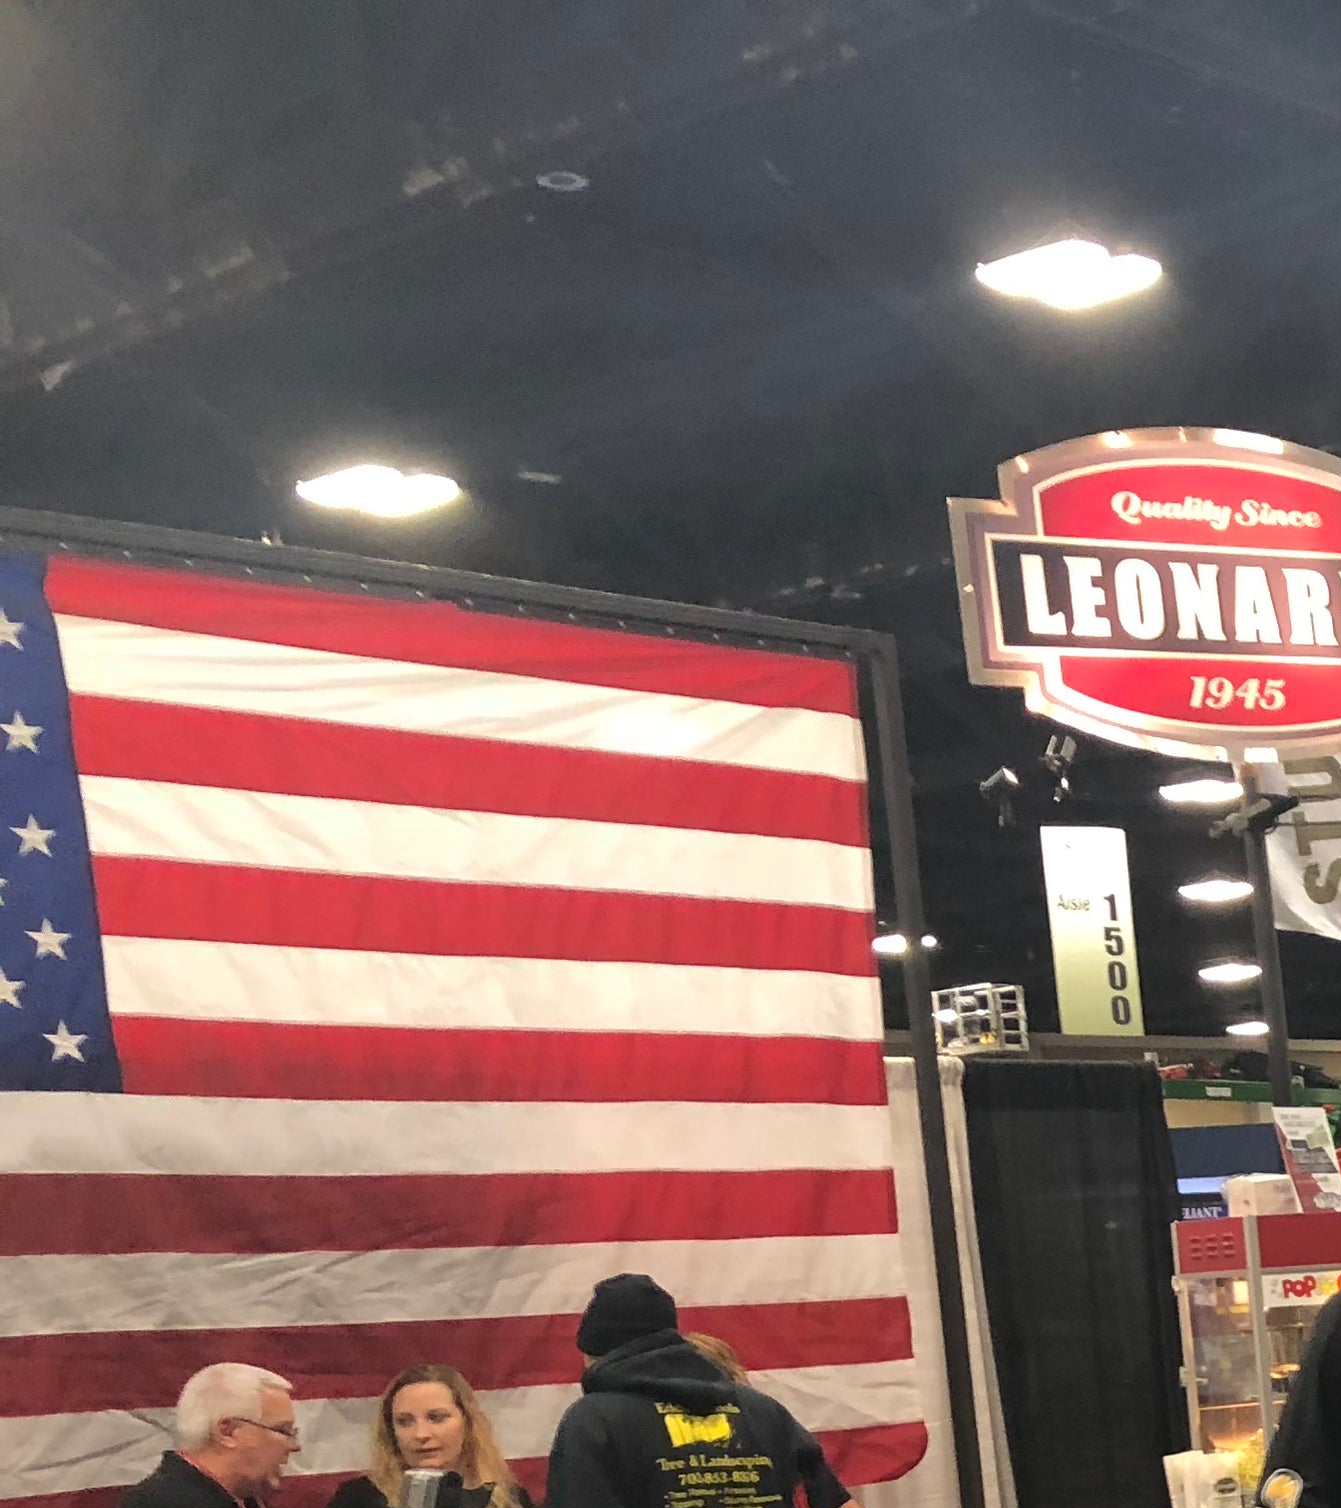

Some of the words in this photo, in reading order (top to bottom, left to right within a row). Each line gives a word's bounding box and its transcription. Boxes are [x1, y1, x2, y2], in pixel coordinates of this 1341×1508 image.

[1111, 490, 1232, 530] Quality
[1234, 501, 1323, 528] Since
[1188, 675, 1287, 712] 1945
[1103, 893, 1132, 1026] 1500
